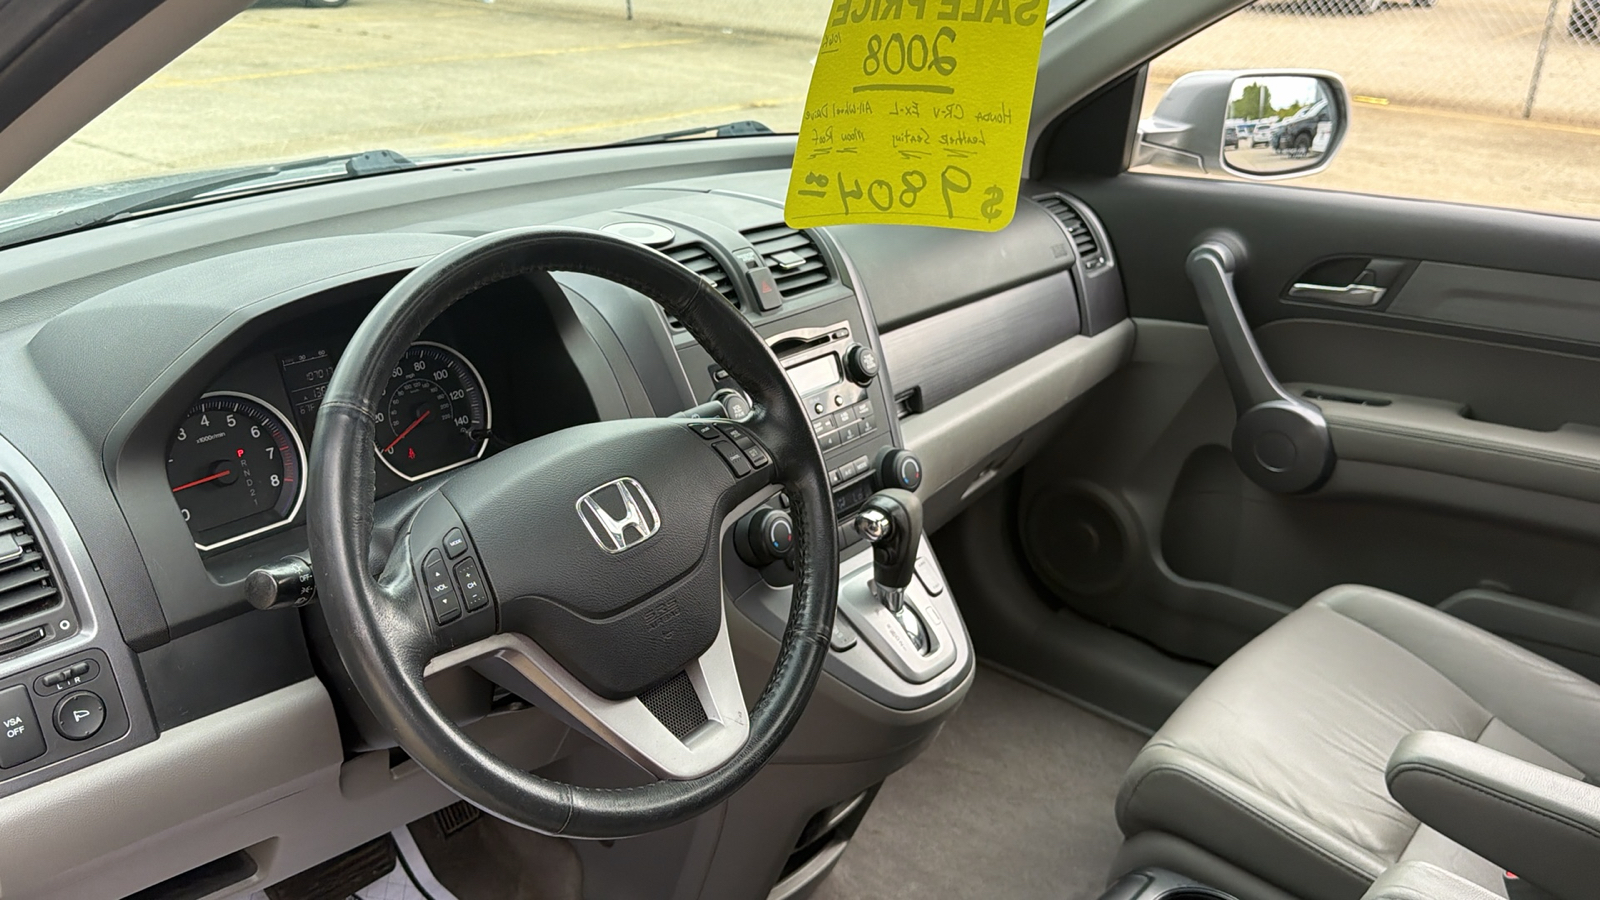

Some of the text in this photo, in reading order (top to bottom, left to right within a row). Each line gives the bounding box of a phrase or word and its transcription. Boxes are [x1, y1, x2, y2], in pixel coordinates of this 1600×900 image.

[413, 360, 426, 372] 80
[433, 368, 449, 381] 100
[449, 388, 465, 401] 120
[200, 414, 210, 427] 4
[226, 414, 236, 427] 5
[454, 415, 469, 427] 140
[177, 428, 187, 441] 3
[250, 426, 260, 438] 6
[236, 449, 244, 458] P
[266, 447, 275, 460] 7
[246, 479, 253, 487] D
[270, 474, 280, 487] 8
[299, 574, 310, 583] OFF
[434, 583, 449, 592] VOL
[466, 581, 477, 590] CH
[74, 676, 81, 684] R
[3, 716, 23, 728] VSA
[7, 725, 25, 738] OFF
